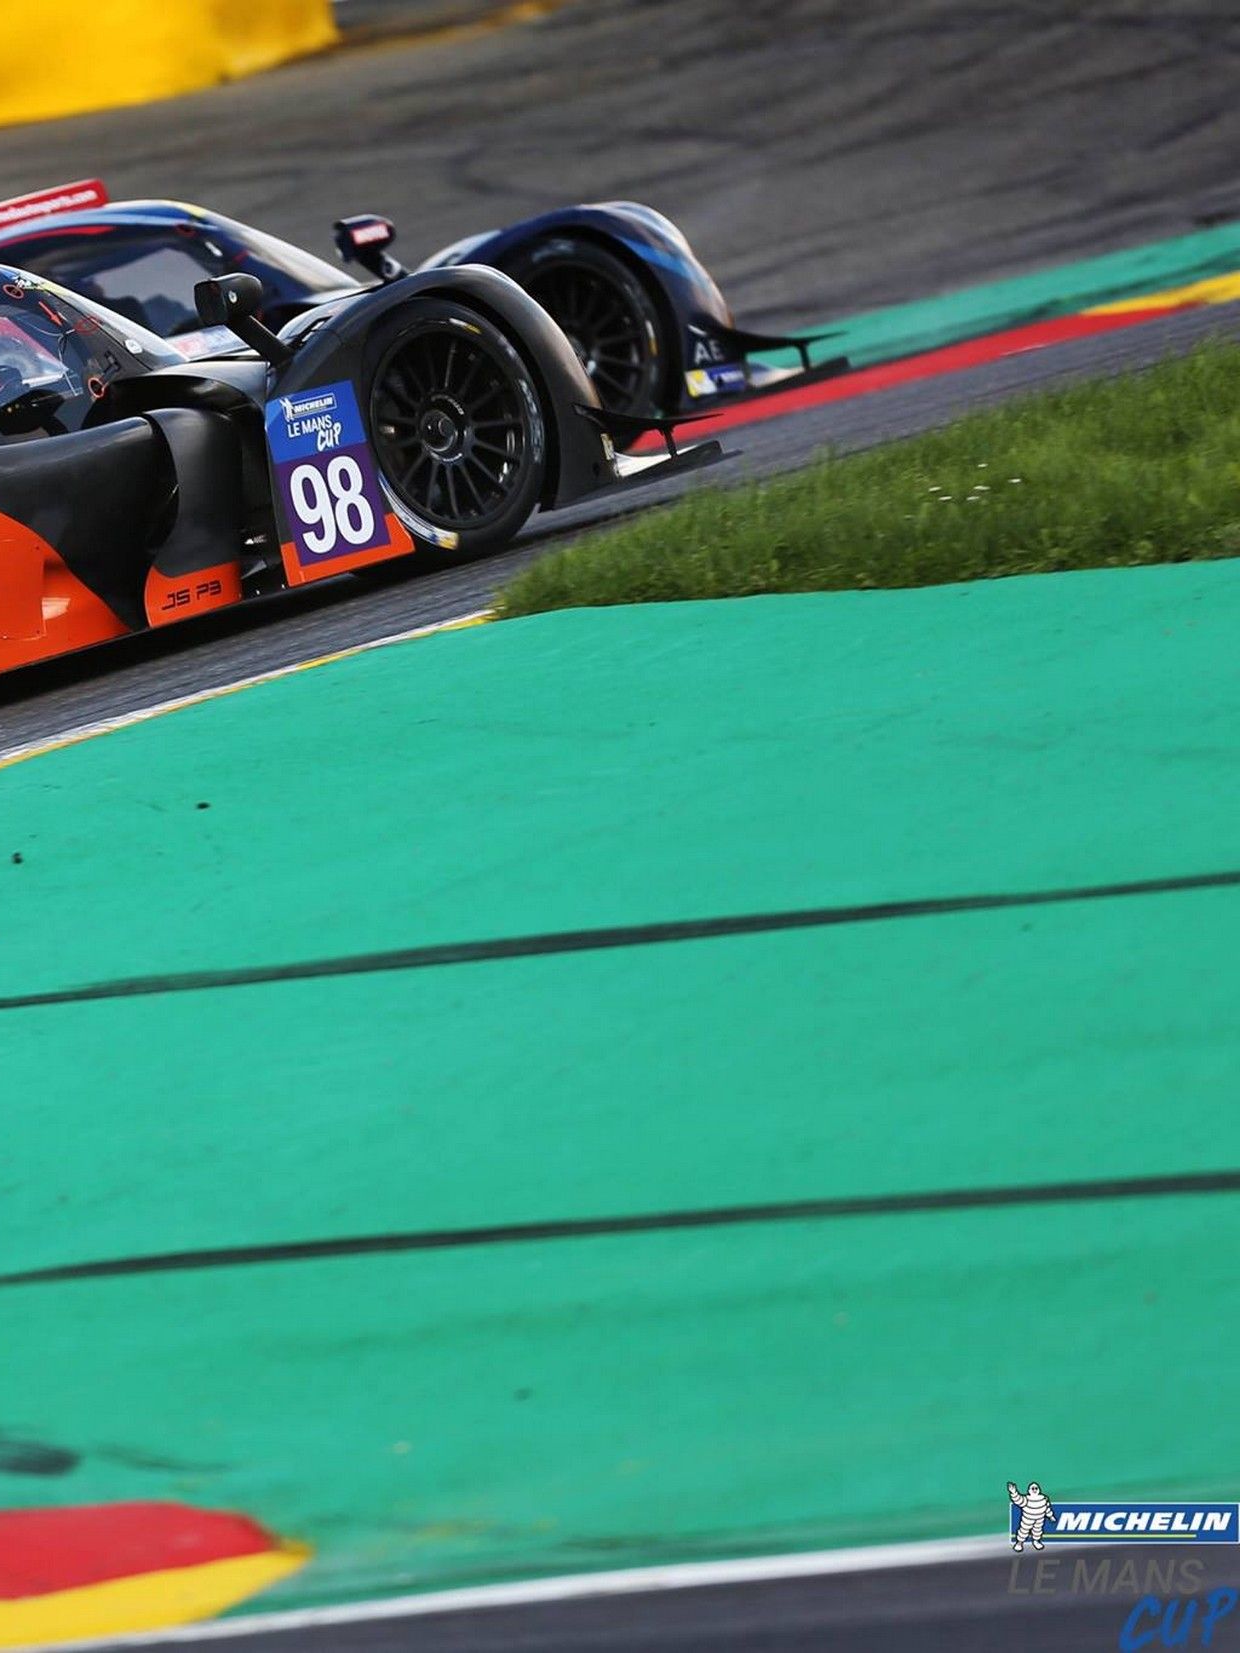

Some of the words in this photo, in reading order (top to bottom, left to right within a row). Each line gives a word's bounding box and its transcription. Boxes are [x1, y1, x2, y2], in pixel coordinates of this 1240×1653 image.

[294, 396, 334, 415] MICHELIN
[287, 421, 301, 438] LE
[301, 414, 333, 434] MANS
[317, 422, 342, 452] CUP
[290, 455, 375, 554] 98
[161, 588, 190, 611] JS
[196, 580, 221, 600] P3
